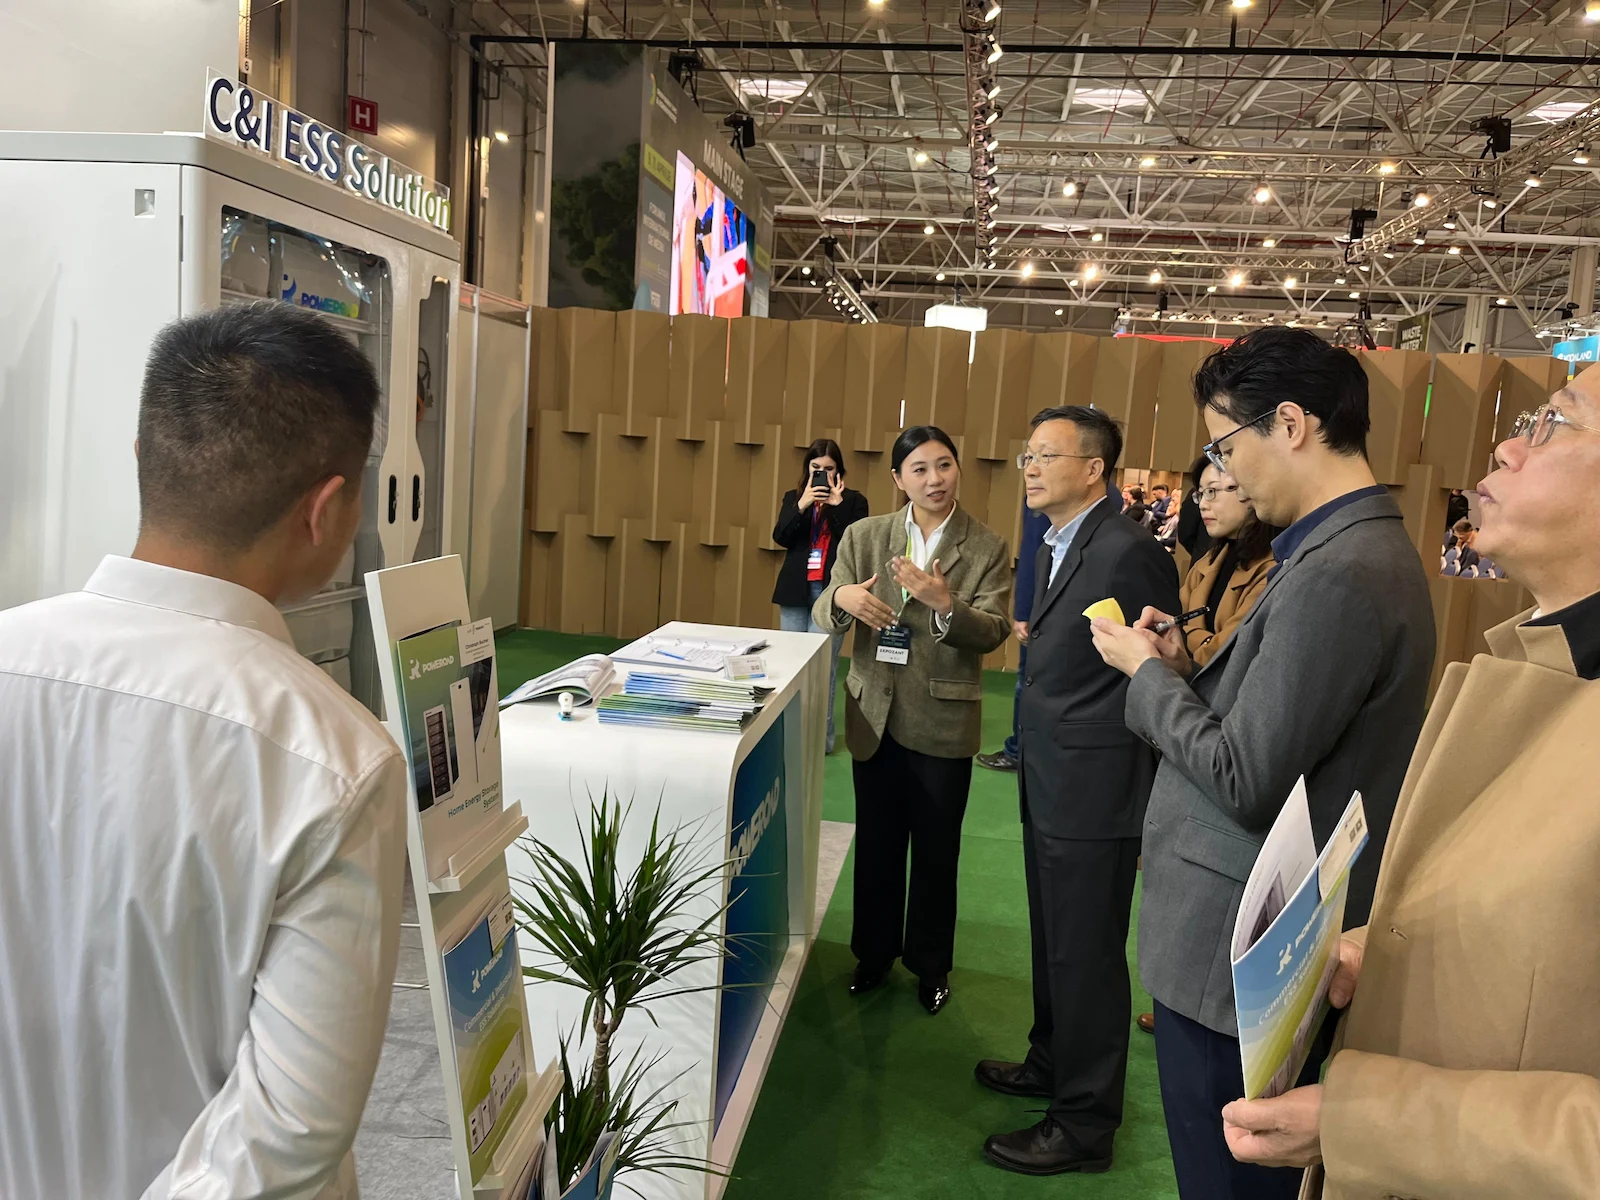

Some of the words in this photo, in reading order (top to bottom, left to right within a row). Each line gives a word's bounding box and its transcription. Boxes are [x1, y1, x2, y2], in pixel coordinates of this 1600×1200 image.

[355, 104, 370, 127] H
[208, 77, 273, 152] C&I
[281, 110, 341, 182] ESS
[344, 144, 451, 231] Solution
[703, 139, 724, 180] MAIN
[723, 161, 744, 200] STAGE
[422, 655, 455, 673] POWEROAD
[448, 804, 464, 818] Home
[465, 793, 481, 808] Energy
[482, 781, 498, 797] Storage
[483, 793, 499, 808] System
